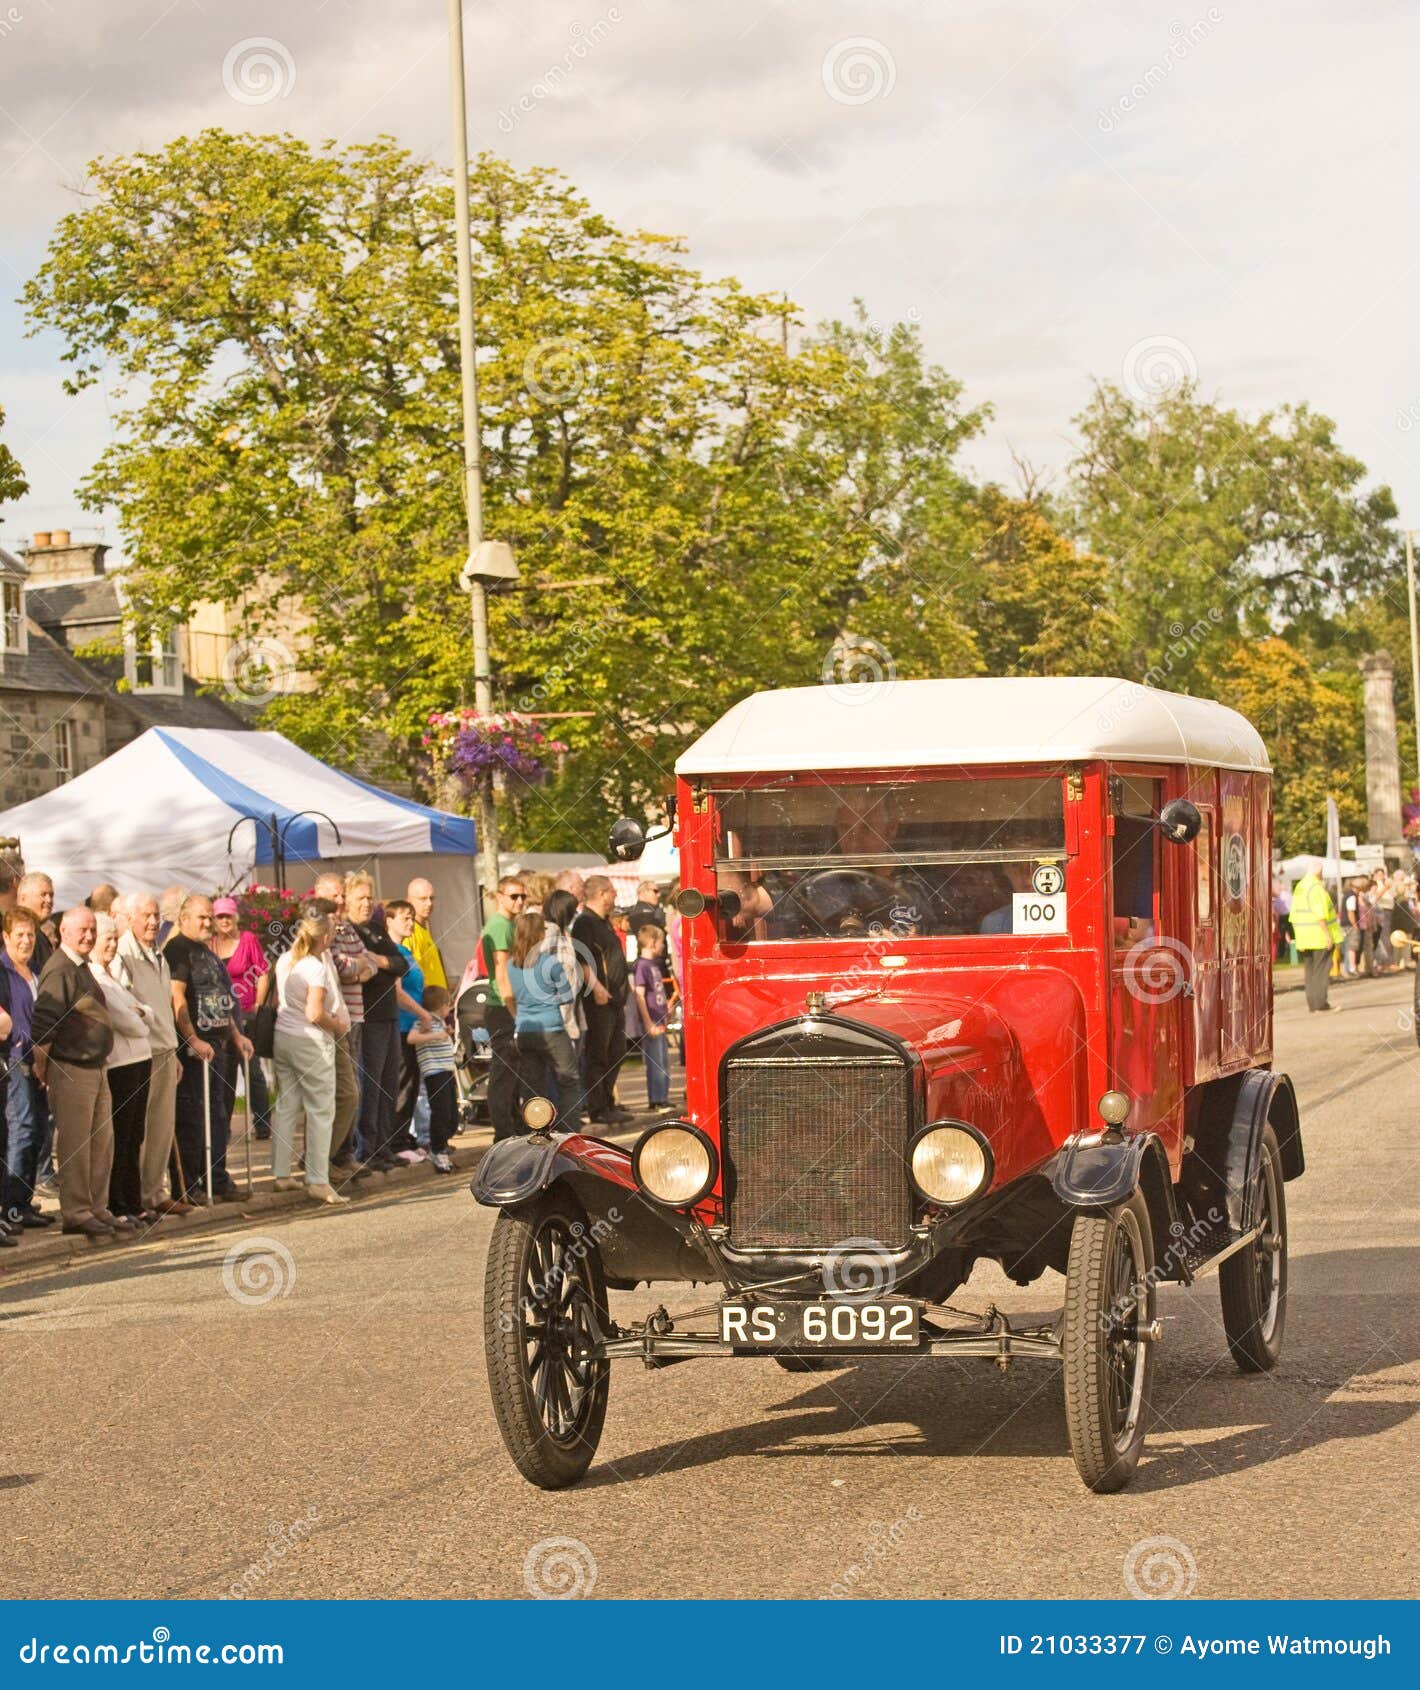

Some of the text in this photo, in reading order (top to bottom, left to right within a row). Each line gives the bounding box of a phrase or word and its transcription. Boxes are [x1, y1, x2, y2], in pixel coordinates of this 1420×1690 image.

[1023, 904, 1056, 921] 100
[722, 1305, 913, 1342] RS 6092
